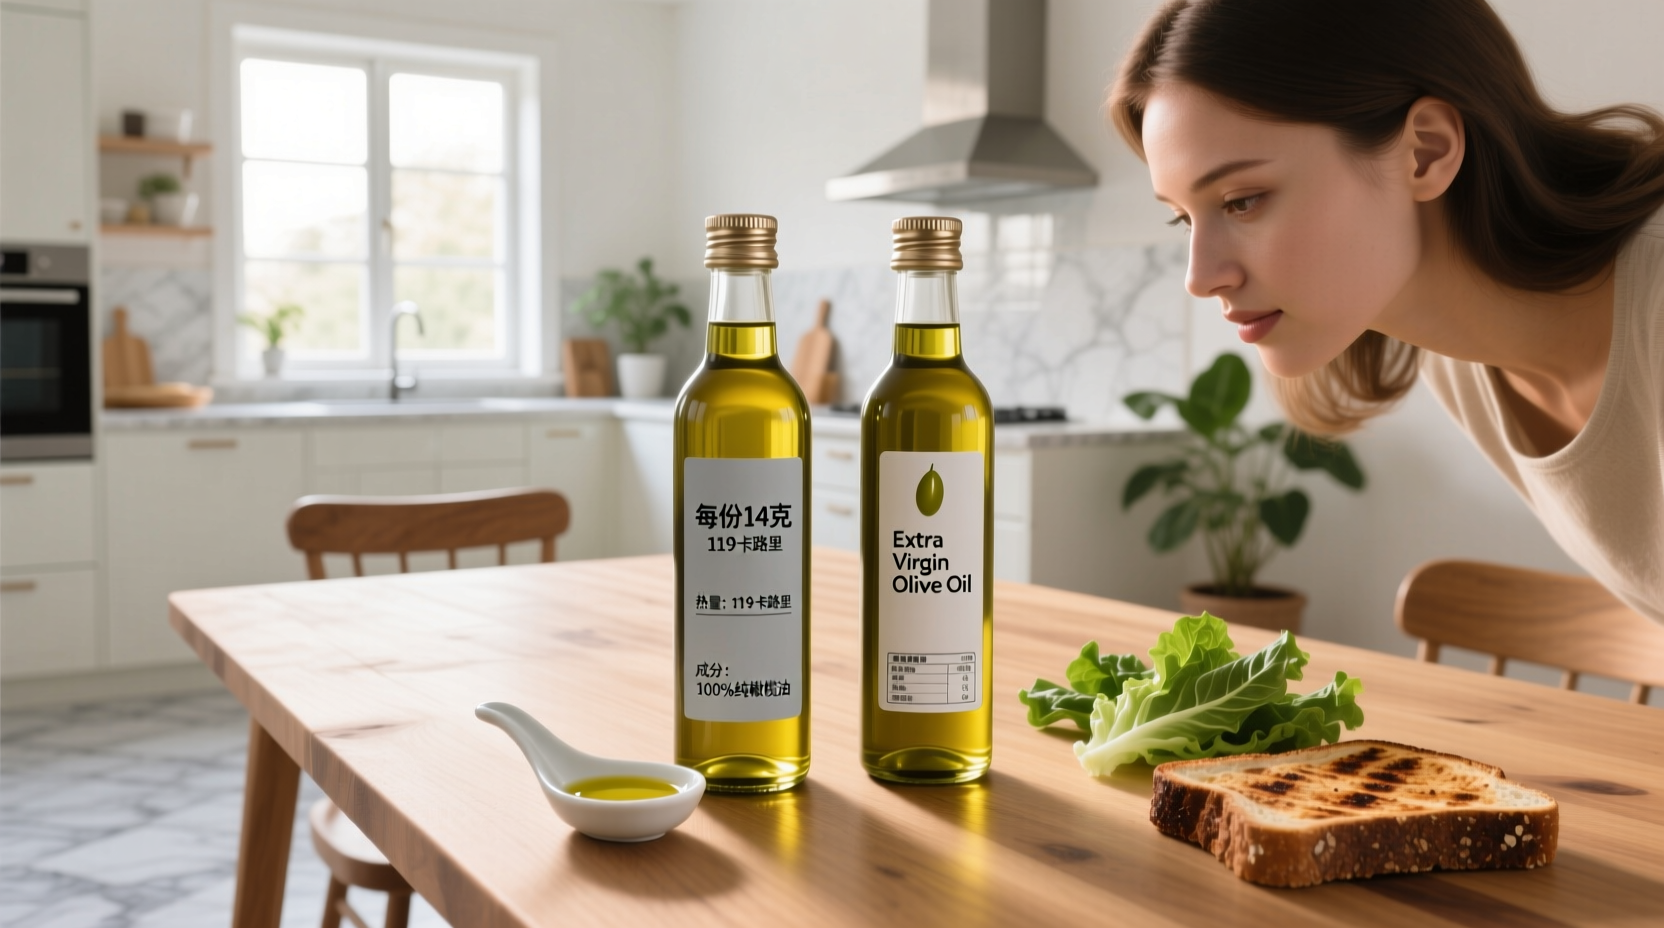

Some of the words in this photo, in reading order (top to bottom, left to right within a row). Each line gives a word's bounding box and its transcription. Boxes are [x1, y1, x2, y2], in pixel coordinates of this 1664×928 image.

[695, 503, 793, 529] 每份14克
[708, 535, 783, 553] 119卡路里
[893, 531, 943, 549] Extra
[893, 553, 949, 576] Virgin
[892, 575, 942, 593] Olive
[946, 574, 972, 593] Oil
